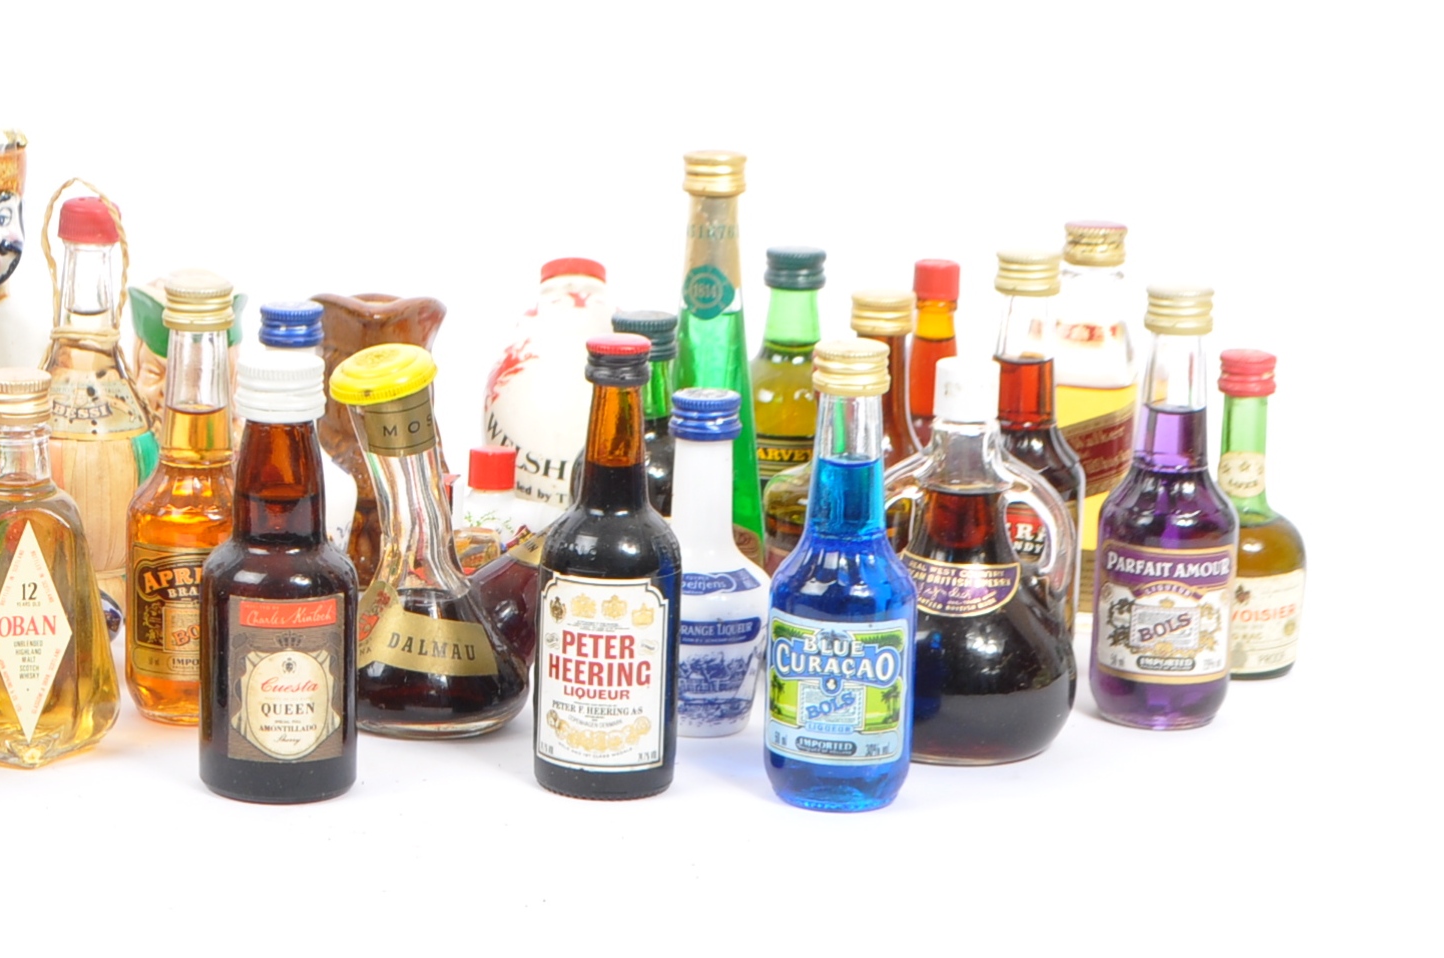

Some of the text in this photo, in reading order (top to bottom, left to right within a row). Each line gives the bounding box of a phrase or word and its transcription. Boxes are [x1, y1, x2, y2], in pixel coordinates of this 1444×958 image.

[382, 413, 433, 437] MOS
[516, 481, 567, 504] led by T
[1013, 541, 1045, 554] NDY
[929, 566, 957, 577] WEST
[1106, 550, 1231, 578] PARFAIT AMOUR
[142, 566, 203, 594] APRI
[21, 582, 38, 601] 12
[167, 585, 200, 599] BRA
[1144, 584, 1192, 597] LIQUEUR
[246, 609, 285, 626] Charles
[172, 624, 201, 647] BO
[681, 621, 754, 636] RANGE LIQUEUR
[1137, 612, 1192, 642] BOLS
[386, 631, 477, 661] DALMAU
[561, 629, 636, 660] PETER
[802, 633, 865, 656] BLUE
[172, 658, 200, 666] IMPO
[548, 653, 652, 688] HEERING
[775, 643, 896, 681] CURAÇAO
[260, 676, 320, 693] Cuesta
[563, 685, 631, 700] LIQUEUR
[260, 702, 315, 718] QUEEN
[551, 699, 576, 713] PETER
[586, 706, 630, 717] HEERING
[805, 691, 857, 720] BOLS
[259, 723, 318, 733] AMONTILLADO
[807, 721, 852, 733] LIQUEUR
[798, 737, 855, 752] IMPORTED
